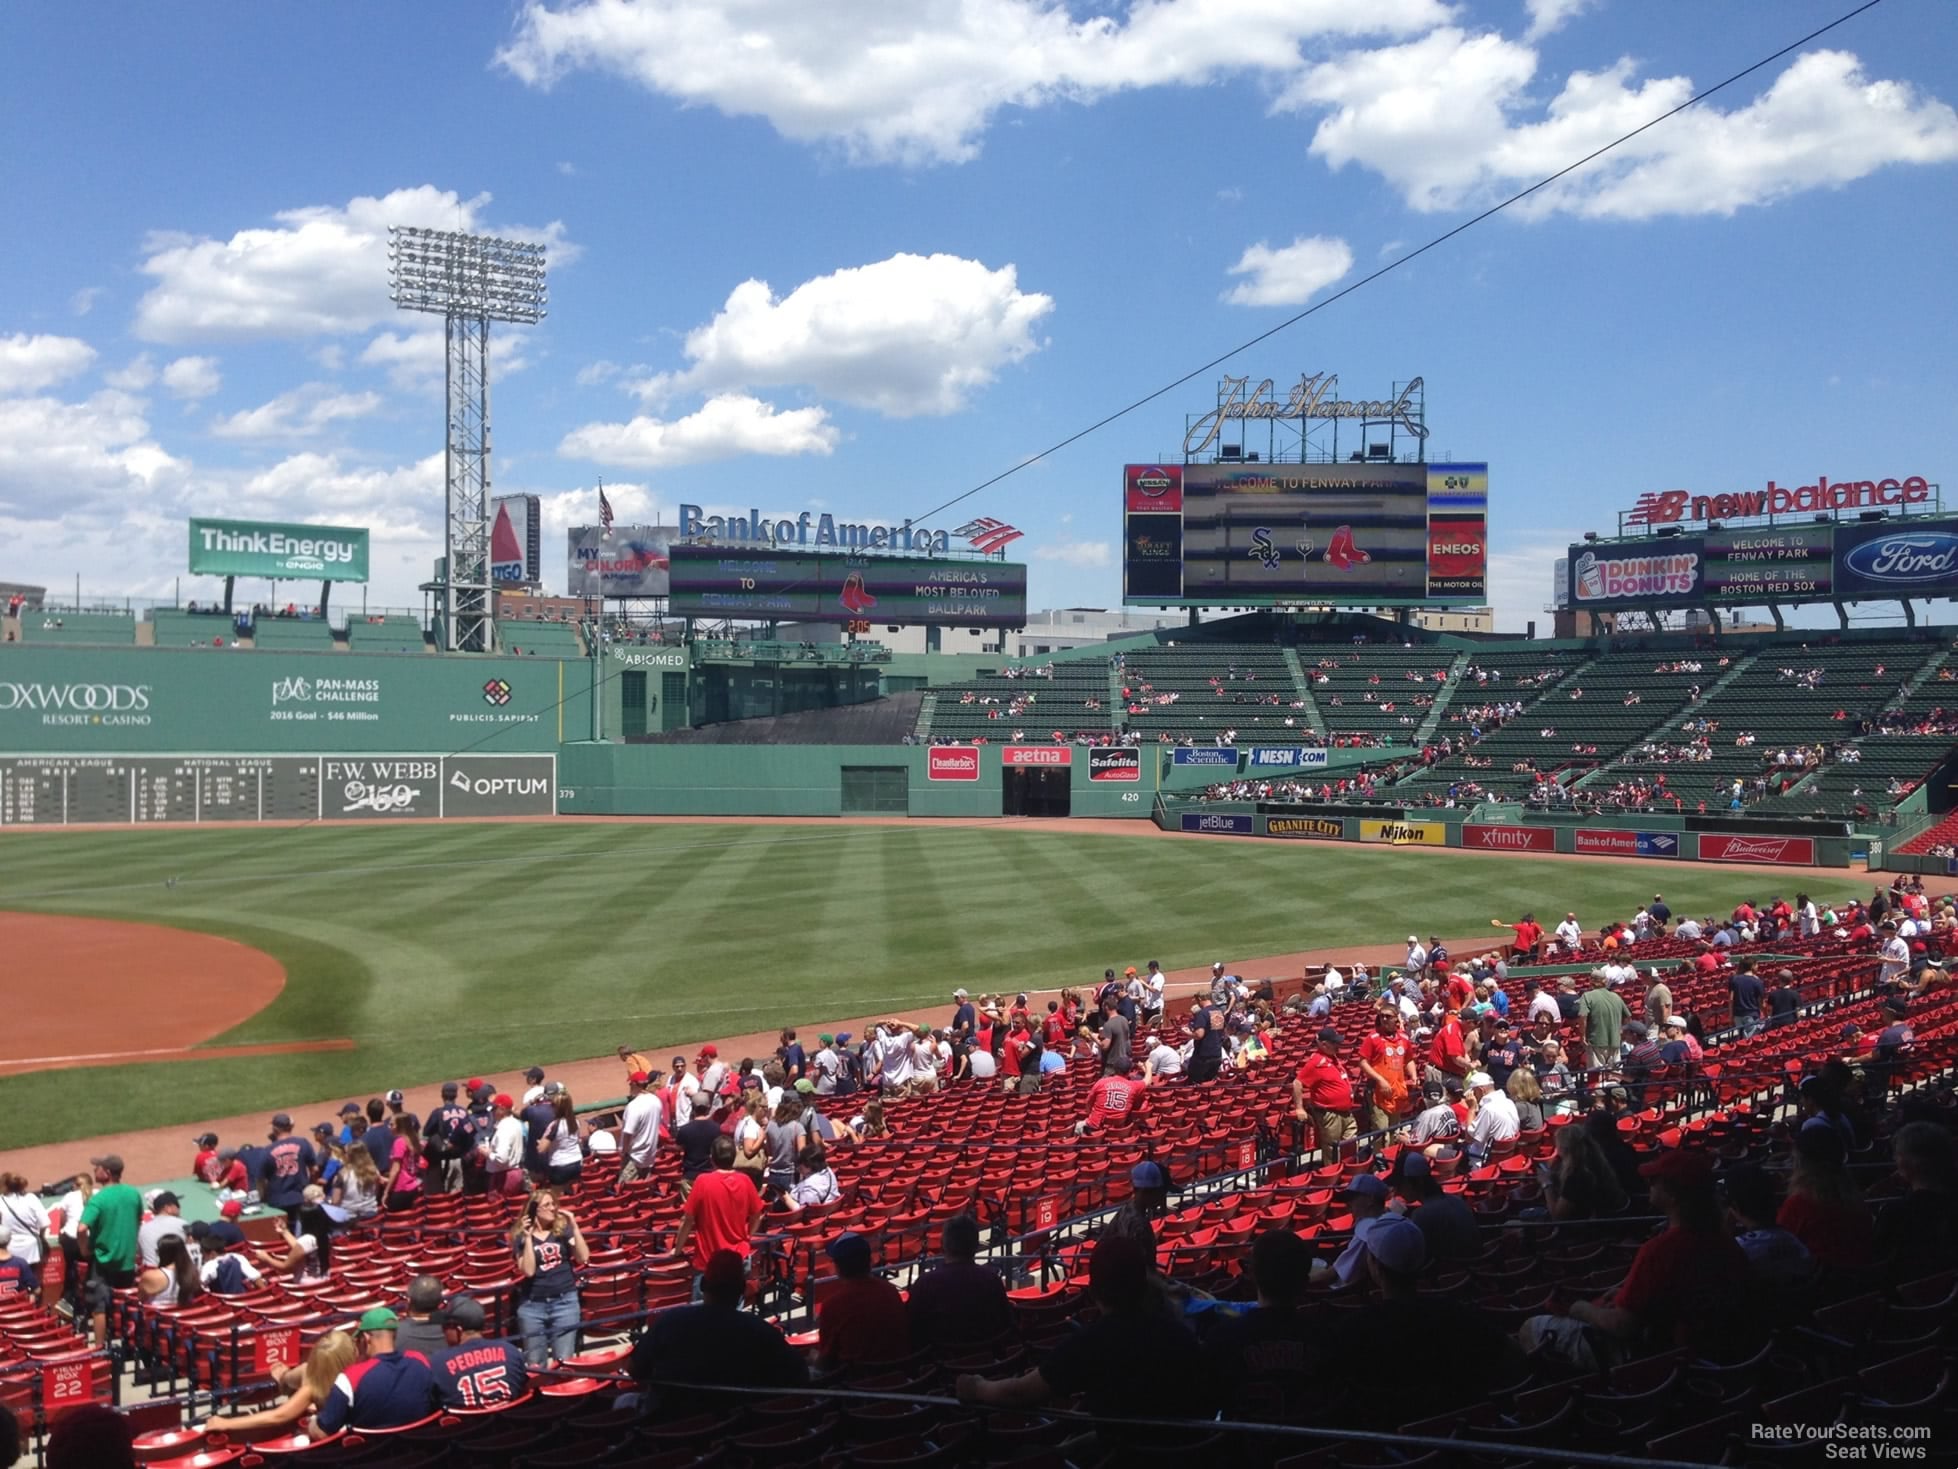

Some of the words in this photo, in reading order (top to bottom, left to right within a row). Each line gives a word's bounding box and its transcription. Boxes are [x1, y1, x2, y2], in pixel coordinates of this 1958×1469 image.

[1281, 372, 1429, 440] Hancock
[1283, 478, 1298, 489] TO
[1302, 478, 1357, 489] FENWAY
[680, 504, 771, 543] Bank
[774, 512, 811, 544] of
[815, 513, 949, 553] America
[200, 528, 353, 562] ThinkEnergy
[1432, 543, 1481, 554] ENEOS
[1732, 537, 1785, 551] WELCOME
[1791, 536, 1804, 547] TO
[577, 548, 599, 559] MY
[1727, 551, 1774, 562] FENWAY
[1778, 549, 1809, 559] PARK
[1871, 540, 1955, 573] Ford
[720, 560, 776, 573] WELCOME
[1608, 556, 1696, 578] DUNKIN'
[929, 571, 987, 583] AMERICA'S
[1730, 572, 1760, 583] HOME
[1765, 571, 1779, 580] OF
[1784, 569, 1806, 579] THE
[740, 578, 755, 589] TO
[1608, 575, 1690, 595] DONUTS
[1720, 584, 1764, 595] BOSTON
[1768, 582, 1790, 592] RED
[1794, 581, 1816, 591] SOX
[915, 586, 946, 598] MOST
[950, 587, 1000, 600] BELOVED
[928, 604, 987, 616] BALLPARK
[625, 655, 683, 665] ABIOMED
[316, 679, 379, 690] PAN-MASS
[315, 691, 379, 702] CHALLENGE
[43, 714, 89, 726] RESORT
[102, 714, 151, 725] CASINO
[270, 711, 293, 720] 2016
[296, 711, 317, 720] Goal
[328, 711, 345, 720] $46
[347, 711, 379, 720] Million
[1013, 748, 1061, 762] aetna
[1186, 755, 1229, 764] Scientific
[1192, 749, 1219, 758] Boston
[1090, 758, 1138, 767] Safelite
[327, 763, 365, 780] F.W.
[372, 762, 437, 779] WEBB
[1104, 771, 1138, 779] AutoGlass
[474, 779, 548, 795] OPTUM
[559, 790, 574, 799] 379
[1121, 793, 1139, 801] 420
[1198, 815, 1234, 830] jetBlue
[1269, 820, 1315, 832] GRANITE
[1317, 820, 1341, 835] CITY
[1380, 825, 1424, 840] Nikon
[1482, 828, 1533, 848] xfinity
[1577, 836, 1600, 846] Bank
[1601, 837, 1610, 846] of
[1610, 838, 1648, 849] America
[1730, 842, 1782, 855] Budweiser
[1104, 1090, 1129, 1111] 15
[1041, 1212, 1052, 1224] 19
[262, 1330, 293, 1340] FIELD
[266, 1337, 287, 1347] BOX
[265, 1347, 287, 1363] 21
[446, 1347, 506, 1376] PEDROIA
[57, 1368, 79, 1381] BOX
[53, 1380, 83, 1399] 22
[457, 1365, 512, 1409] 15
